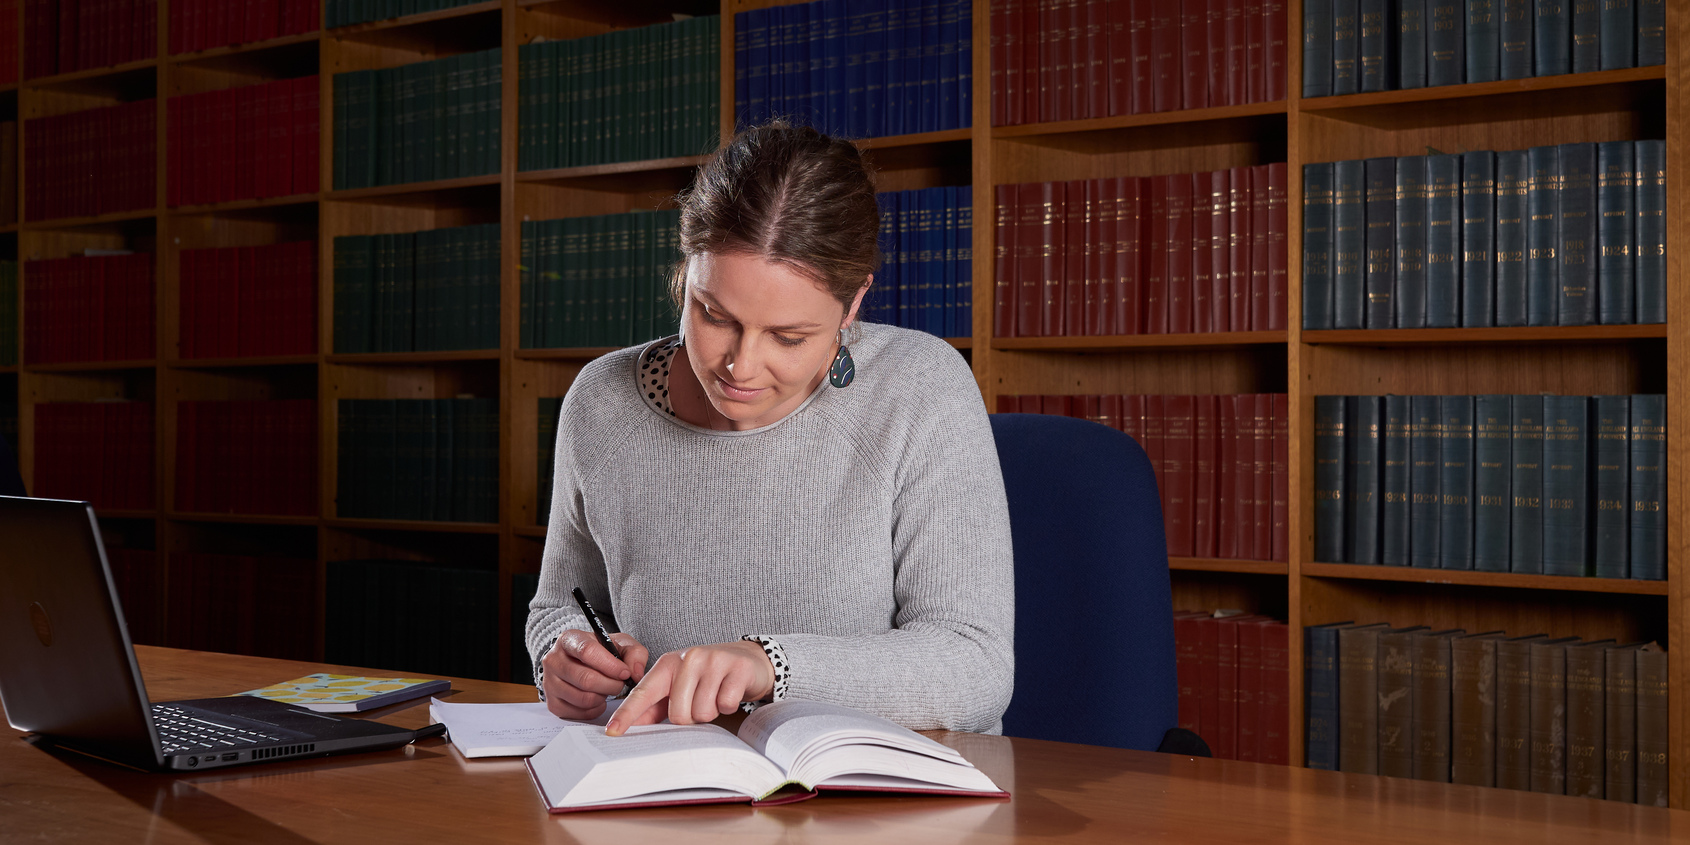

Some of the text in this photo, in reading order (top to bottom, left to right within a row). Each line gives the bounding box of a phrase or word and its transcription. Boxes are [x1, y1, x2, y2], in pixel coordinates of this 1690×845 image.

[1434, 6, 1454, 17] 1900
[1538, 6, 1561, 17] 1910
[1434, 20, 1453, 31] 1903
[1335, 30, 1354, 41] 1899
[1529, 248, 1555, 259] 1923
[1602, 245, 1629, 256] 1924
[1428, 253, 1453, 264] 1920
[1464, 251, 1486, 262] 1921
[1497, 251, 1522, 262] 1922
[1370, 263, 1389, 273] 1917
[1384, 491, 1406, 503] 1928
[1413, 493, 1438, 504] 1929
[1443, 494, 1468, 505] 1930
[1480, 495, 1502, 506] 1931
[1514, 496, 1539, 507] 1932
[1550, 498, 1574, 509] 1933
[1635, 500, 1660, 512] 1935
[1500, 738, 1524, 749] 1937
[1532, 741, 1554, 754] 1937
[1571, 744, 1595, 757] 1937
[1605, 750, 1630, 761] 1937
[1639, 752, 1666, 765] 1938
